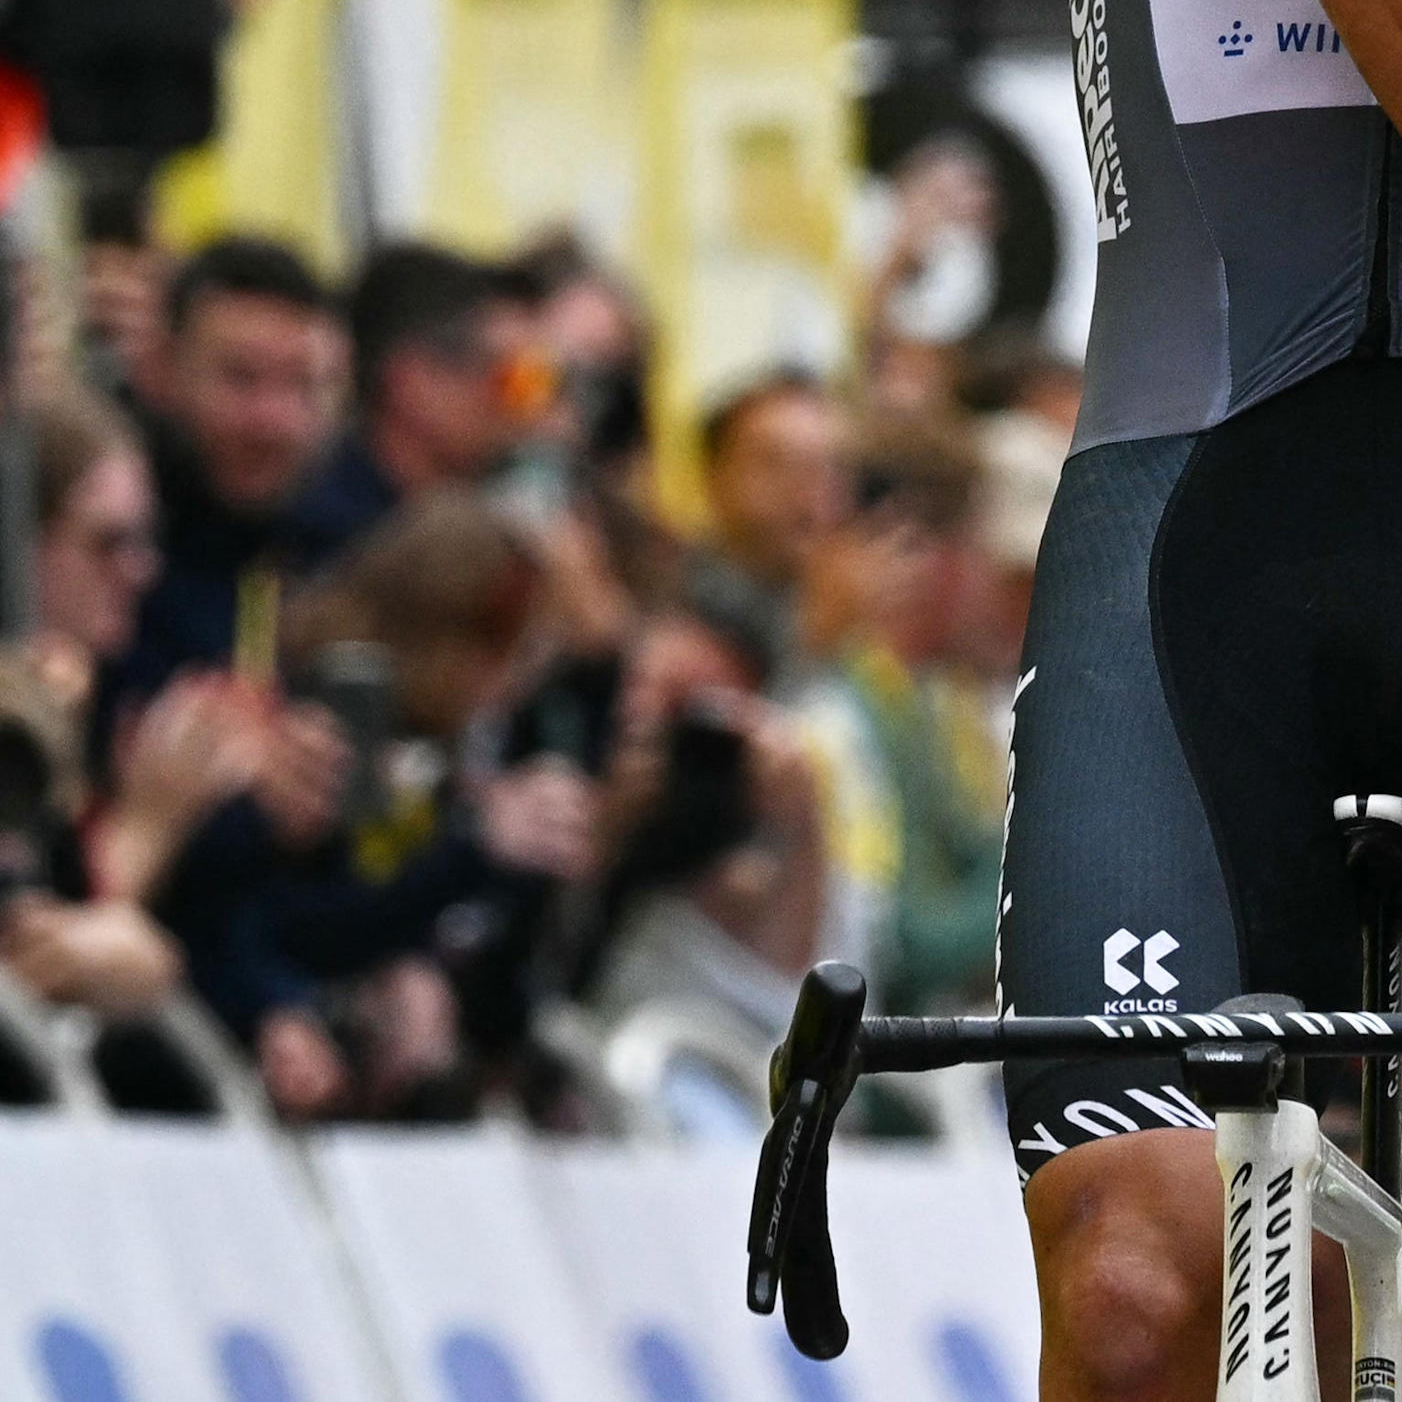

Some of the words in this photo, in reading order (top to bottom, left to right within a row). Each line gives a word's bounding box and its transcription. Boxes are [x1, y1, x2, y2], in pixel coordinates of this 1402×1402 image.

[1106, 123, 1131, 233] HAIR
[1205, 1050, 1243, 1062] wahoo
[1226, 1162, 1253, 1385] CANYON
[1263, 1166, 1294, 1380] CANYON
